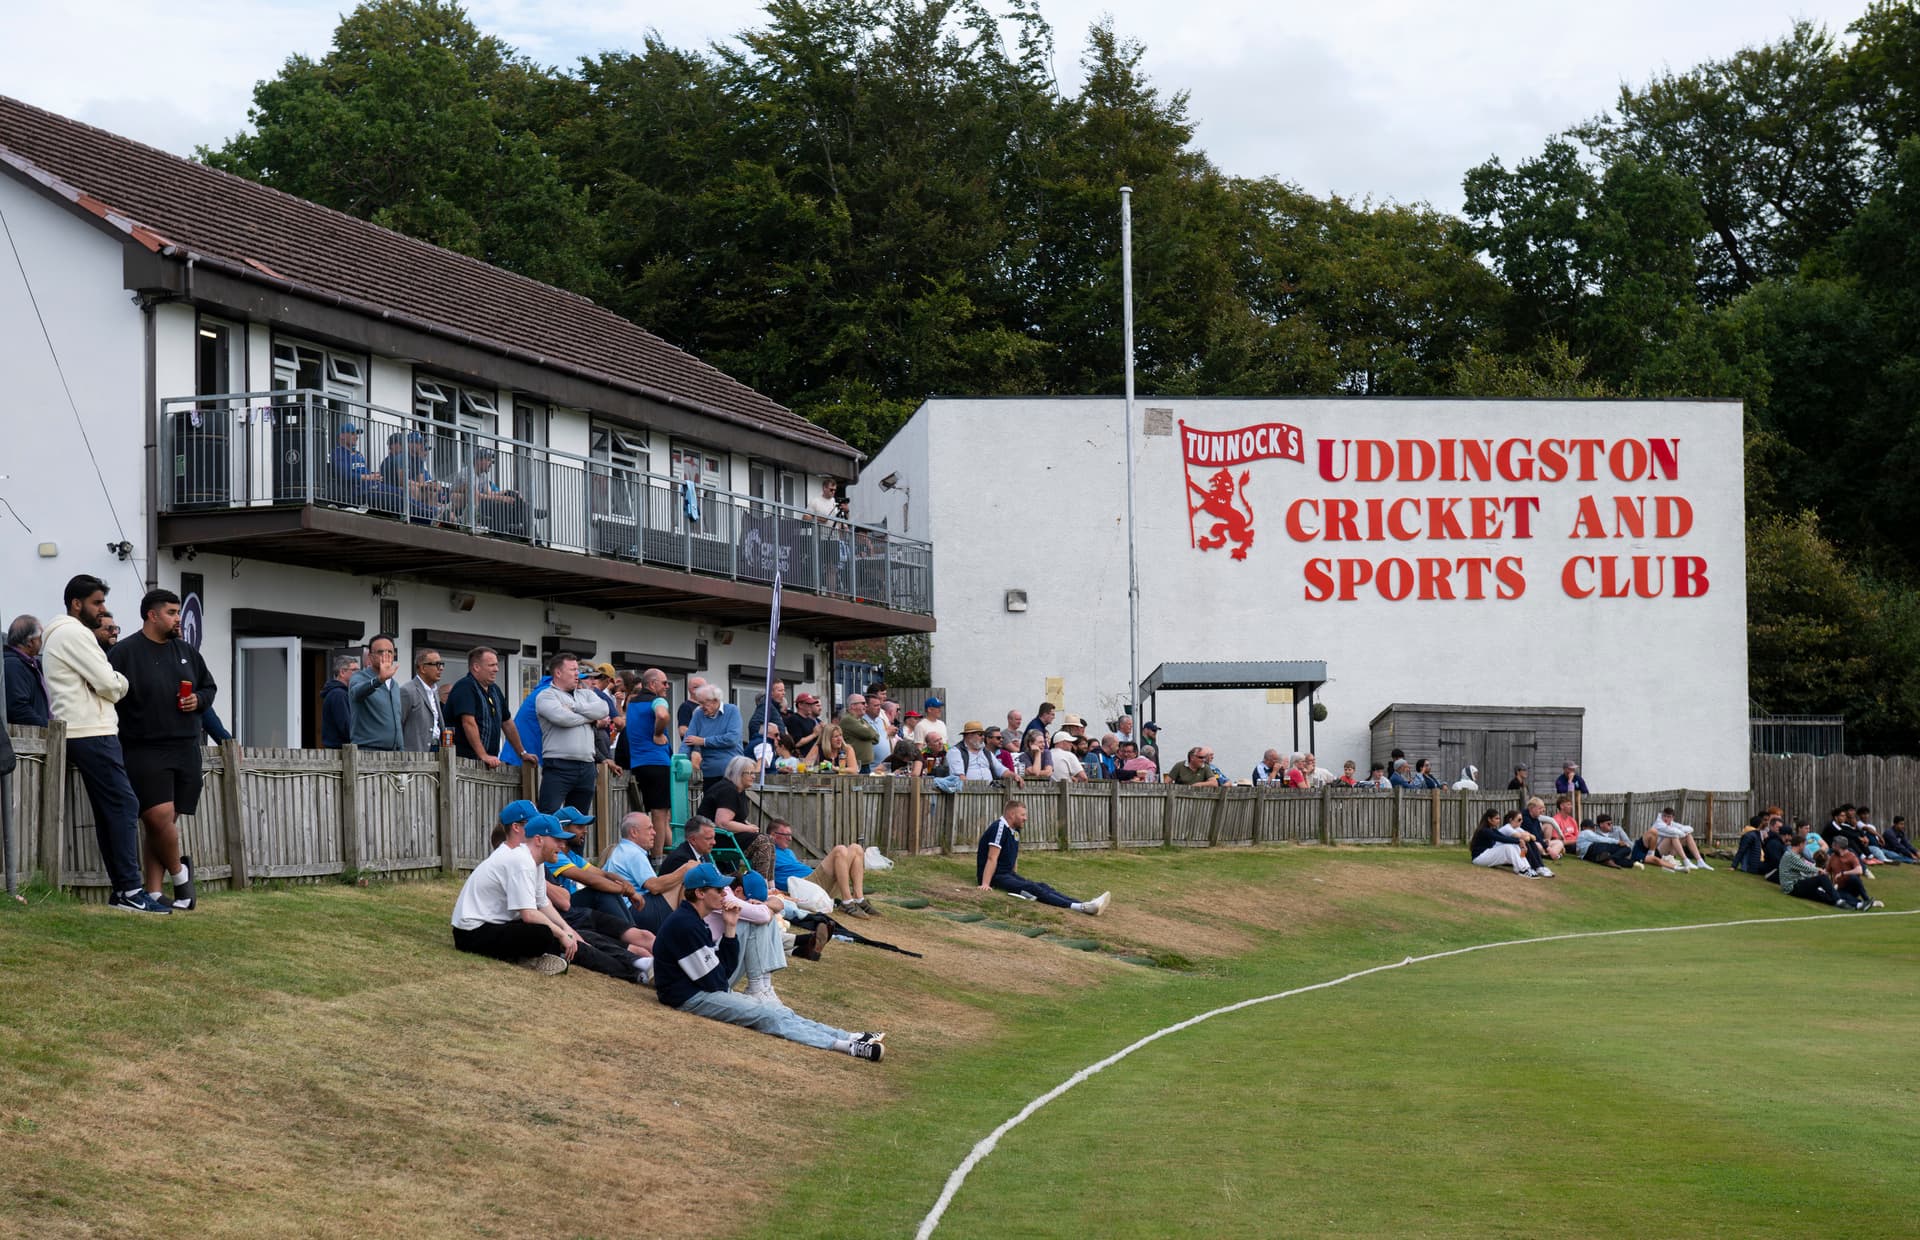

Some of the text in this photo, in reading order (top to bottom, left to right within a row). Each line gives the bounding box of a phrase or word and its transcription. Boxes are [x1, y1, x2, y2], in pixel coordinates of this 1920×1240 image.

[1186, 426, 1299, 462] TUNNOCK'S
[1318, 438, 1680, 482] UDDINGSTON
[1286, 495, 1694, 542] CRICKET AND
[1304, 556, 1710, 601] SPORTS CLUB
